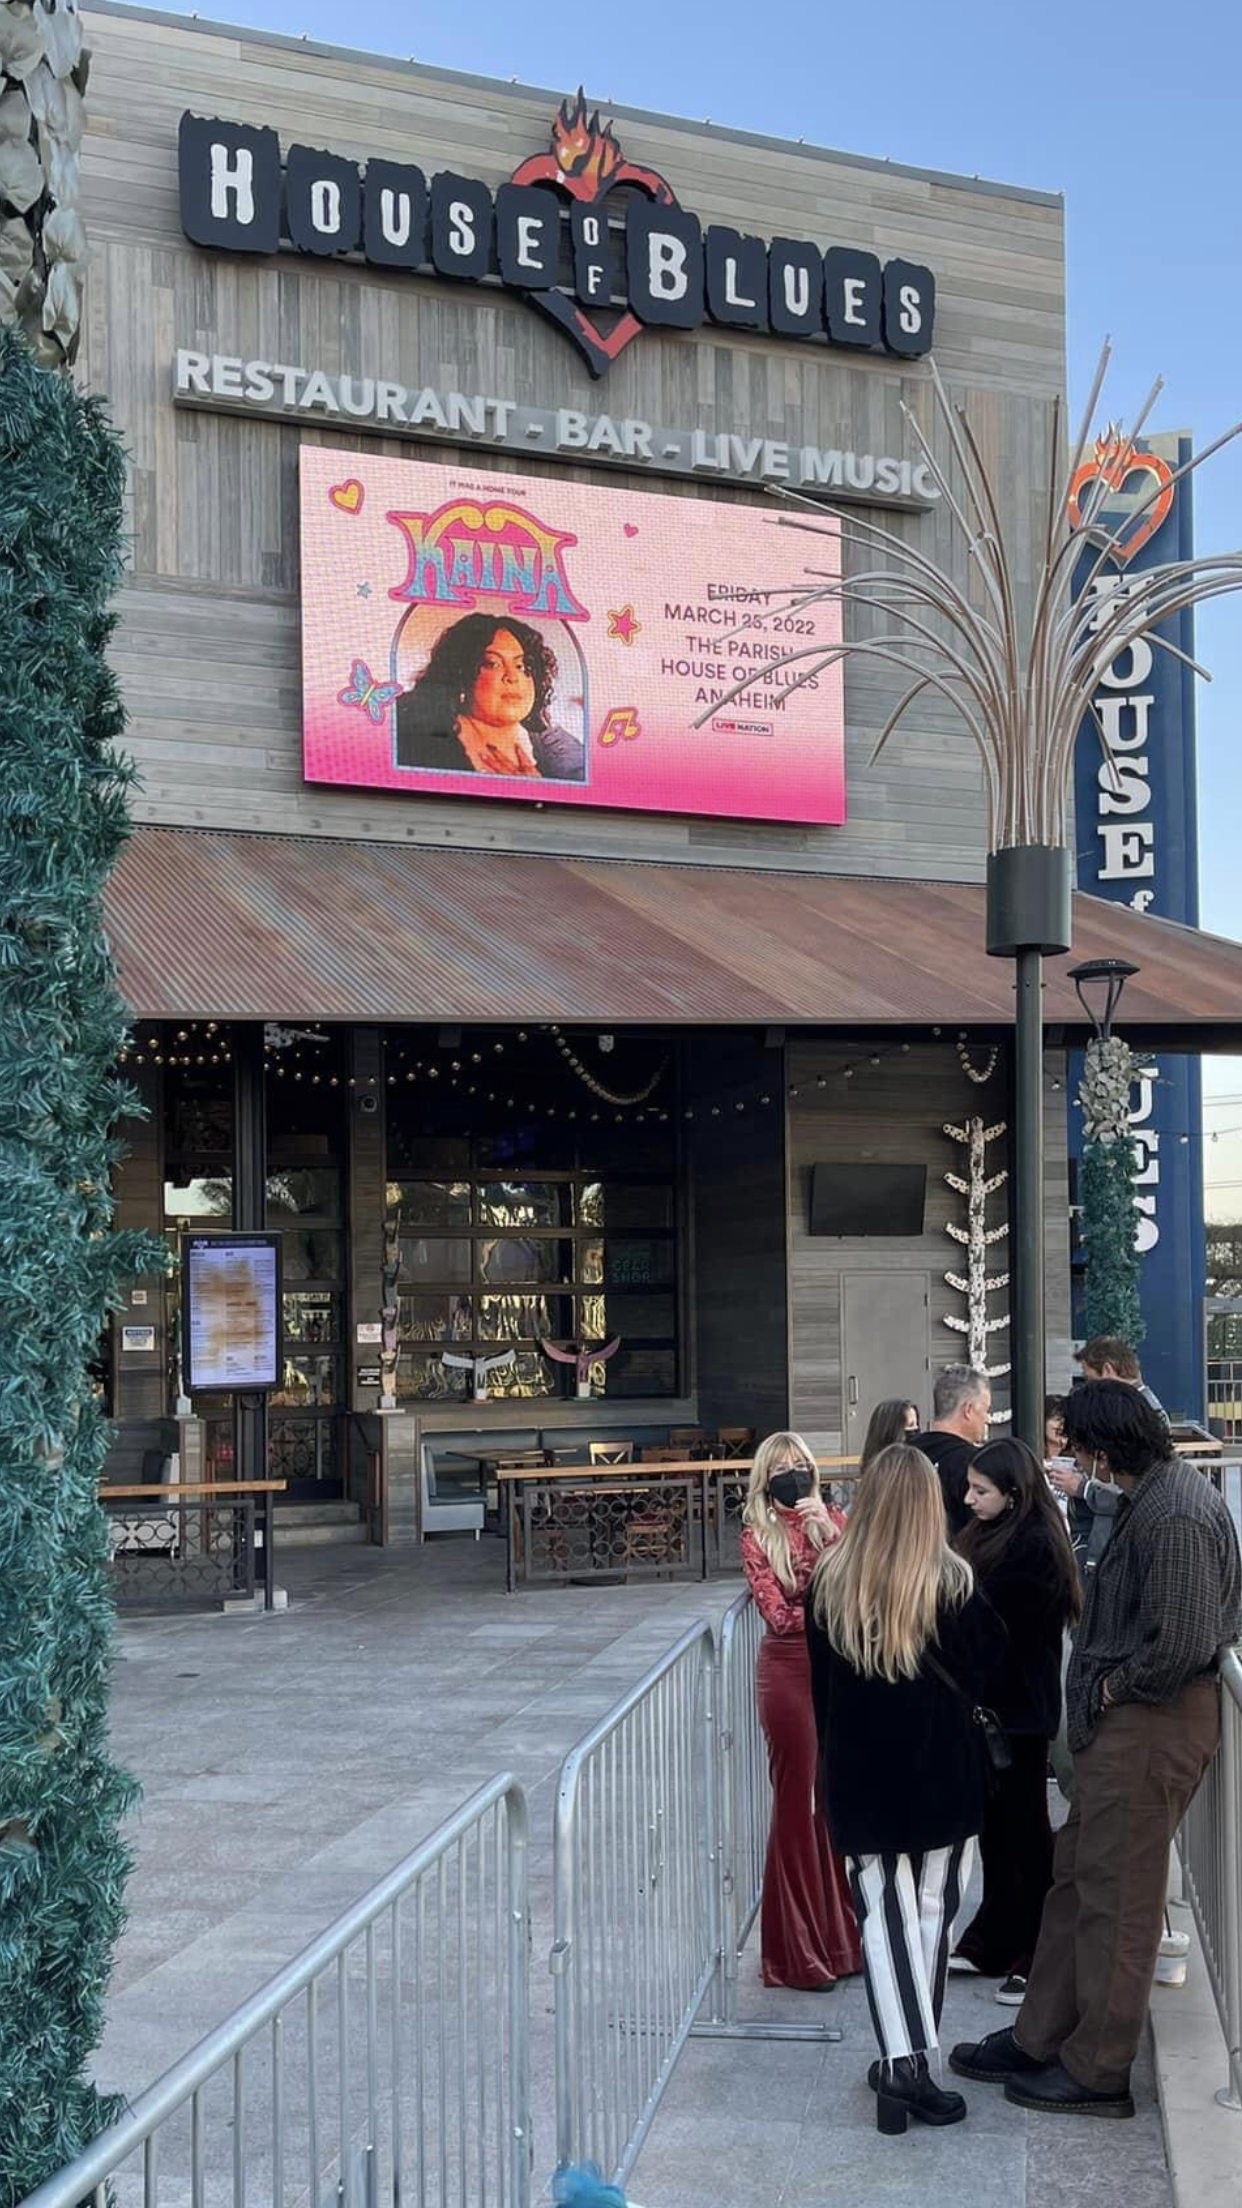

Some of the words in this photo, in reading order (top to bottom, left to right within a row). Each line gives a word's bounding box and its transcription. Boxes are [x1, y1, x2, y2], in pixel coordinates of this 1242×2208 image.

[211, 143, 544, 270] HOUSE
[583, 216, 605, 294] OF
[648, 232, 923, 334] BLUES
[175, 348, 517, 441] RESTAURANT
[556, 408, 654, 460] BAR
[692, 429, 790, 482] LIVE
[800, 445, 943, 499] MUSIC
[388, 499, 588, 619] KAINA
[706, 583, 772, 605] FRIDAY
[664, 603, 737, 626] MARCH
[741, 612, 768, 632] 25,
[773, 616, 816, 635] 2022
[686, 635, 723, 655] THE
[728, 640, 794, 661] PARISH
[661, 658, 727, 680] HOUSE
